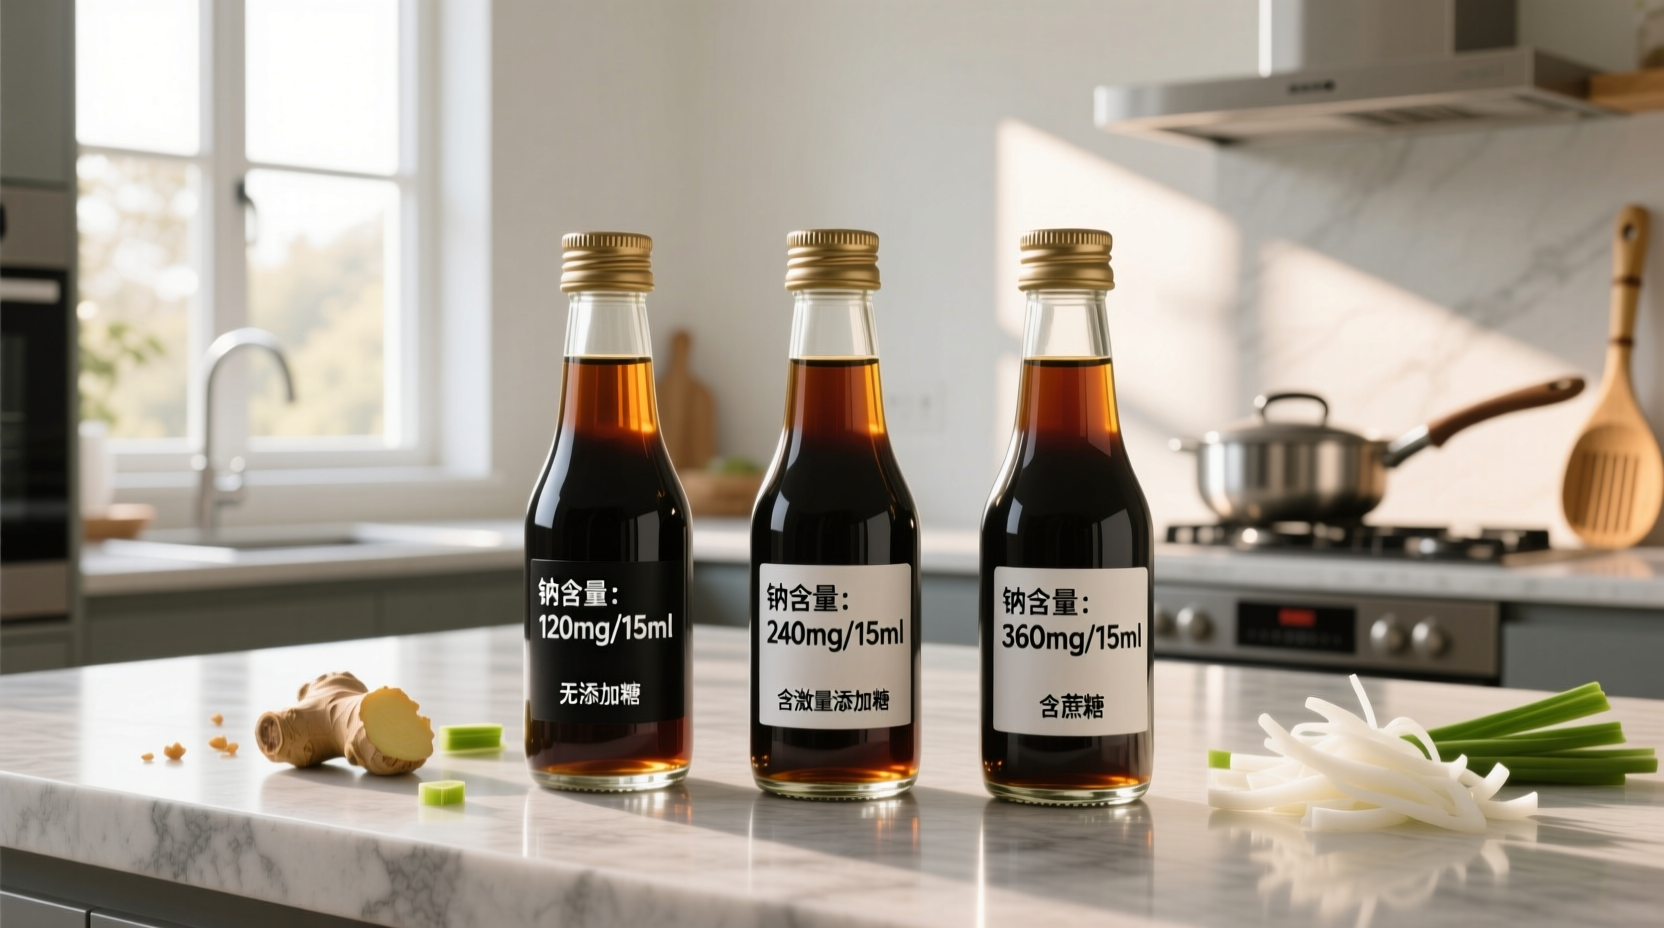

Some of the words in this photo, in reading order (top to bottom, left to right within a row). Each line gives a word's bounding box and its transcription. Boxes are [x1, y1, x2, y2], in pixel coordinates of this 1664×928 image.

[538, 577, 618, 607] 钠含量：
[767, 583, 848, 612] 钠含量：
[1003, 587, 1089, 616] 钠含量：
[539, 613, 673, 646] 120mg/15ml
[767, 619, 904, 652] 240mg/15ml
[1002, 623, 1142, 657] 360mg/15ml
[560, 682, 641, 706] 无添加糖
[1039, 693, 1105, 719] 含蔗糖
